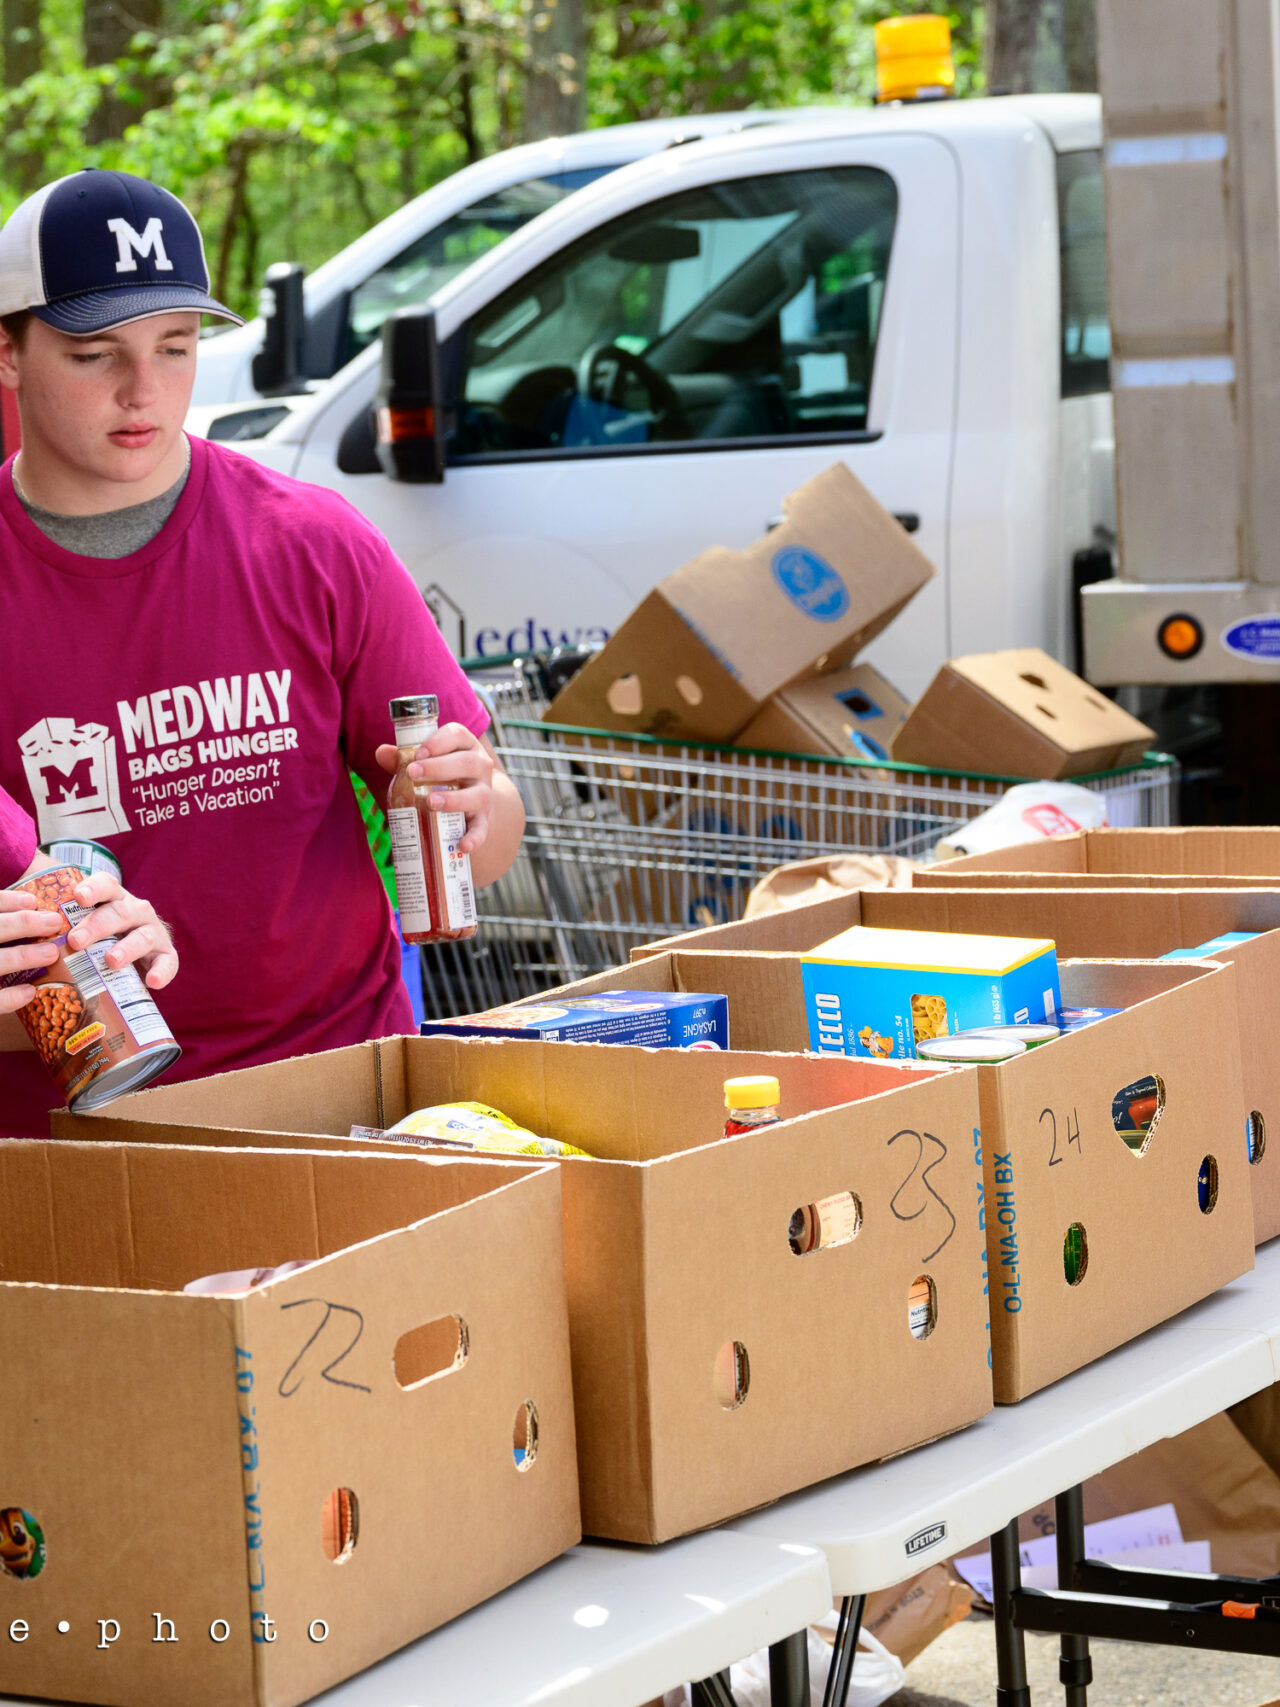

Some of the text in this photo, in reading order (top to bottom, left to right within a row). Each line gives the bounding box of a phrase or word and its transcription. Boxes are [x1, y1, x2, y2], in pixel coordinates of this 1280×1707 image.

[107, 217, 173, 273] M
[116, 669, 292, 753] MEDWAY
[39, 757, 98, 805] M
[128, 727, 300, 781] BAGS HUNGER
[135, 802, 175, 827] Take
[179, 801, 190, 816] a
[683, 1020, 716, 1037] LASAGNE
[847, 1028, 856, 1045] 1886
[895, 1015, 903, 1027] 54
[1039, 1107, 1082, 1166] 24
[887, 1129, 956, 1263] 23
[993, 1151, 1022, 1313] O-L-NA-OH BX
[278, 1298, 372, 1397] 22
[908, 1527, 943, 1552] LIFETIME
